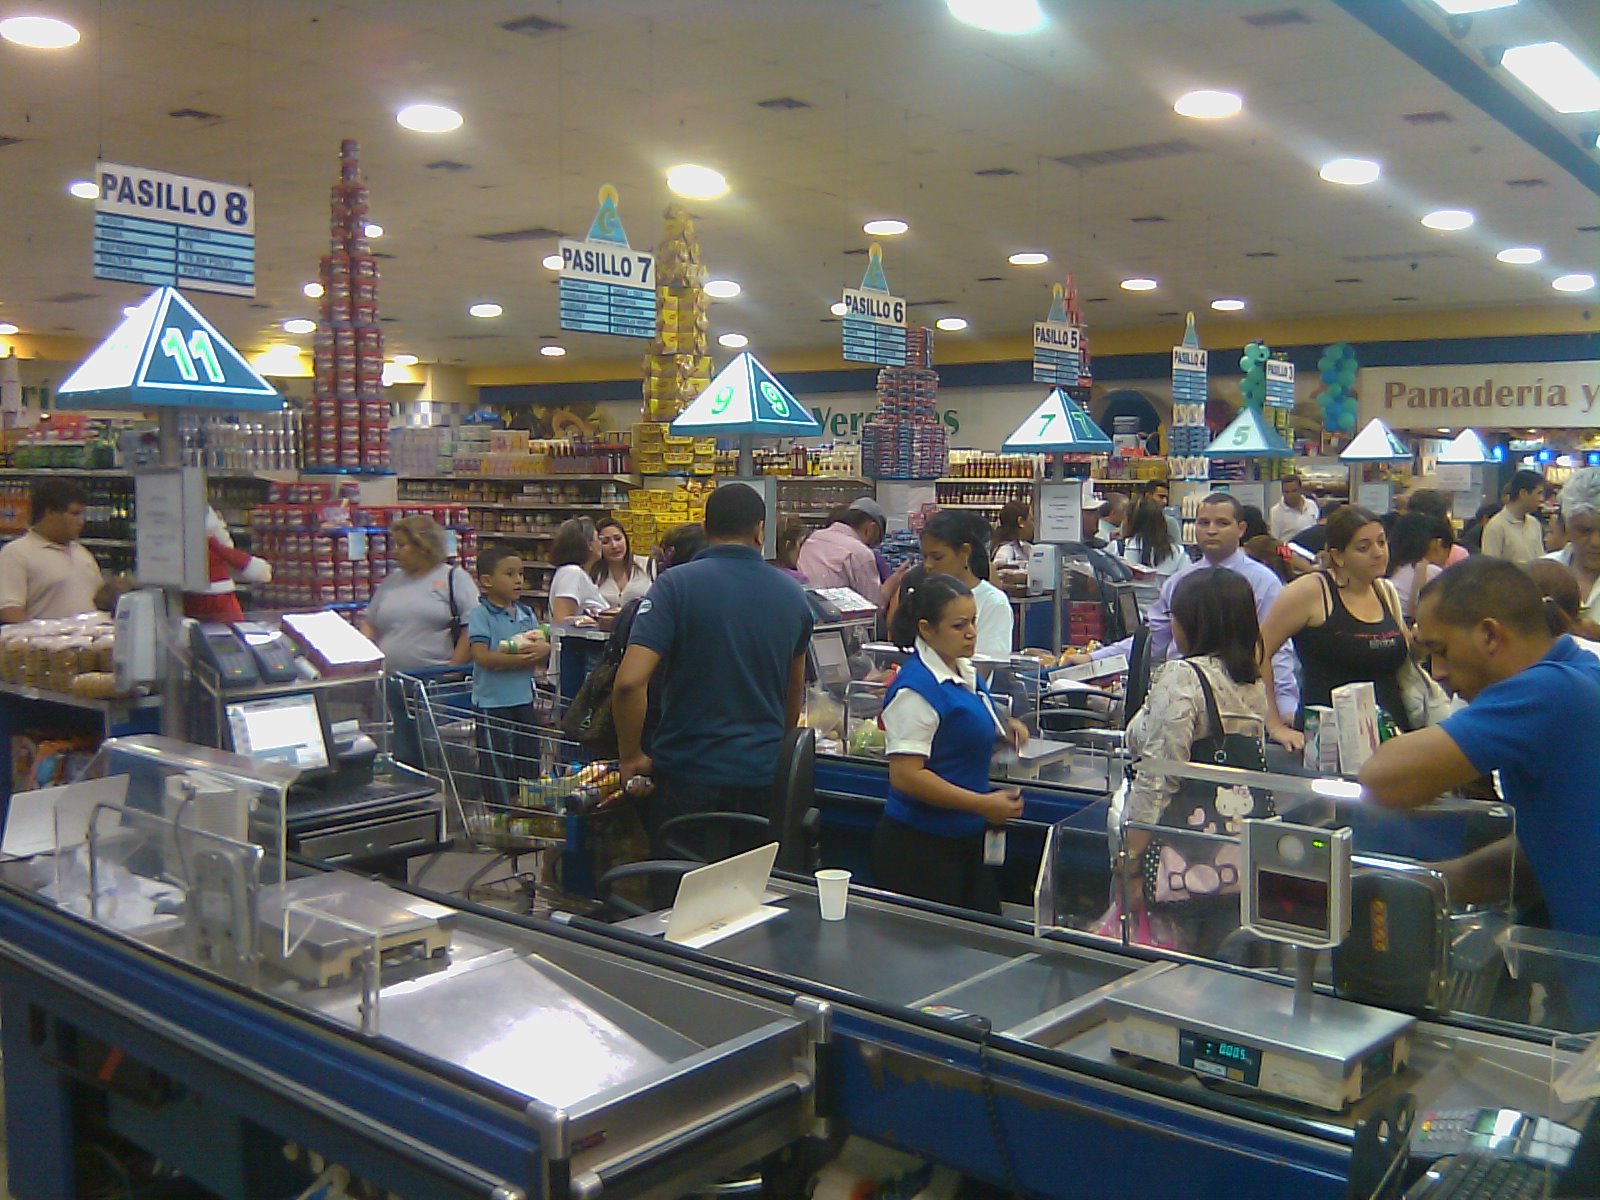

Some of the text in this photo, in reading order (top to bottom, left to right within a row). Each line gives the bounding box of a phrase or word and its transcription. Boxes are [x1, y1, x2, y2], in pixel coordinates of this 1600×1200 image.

[101, 172, 248, 226] PASILLO 8
[562, 248, 652, 283] PASILLO 7
[845, 294, 904, 323] PASILLO 6
[1035, 327, 1078, 349] PASILLO 5
[161, 327, 226, 383] 11
[1199, 351, 1206, 368] 4
[710, 386, 735, 416] 9
[1384, 378, 1600, 414] Panadería y
[1038, 413, 1056, 437] 7
[1231, 425, 1251, 446] 5
